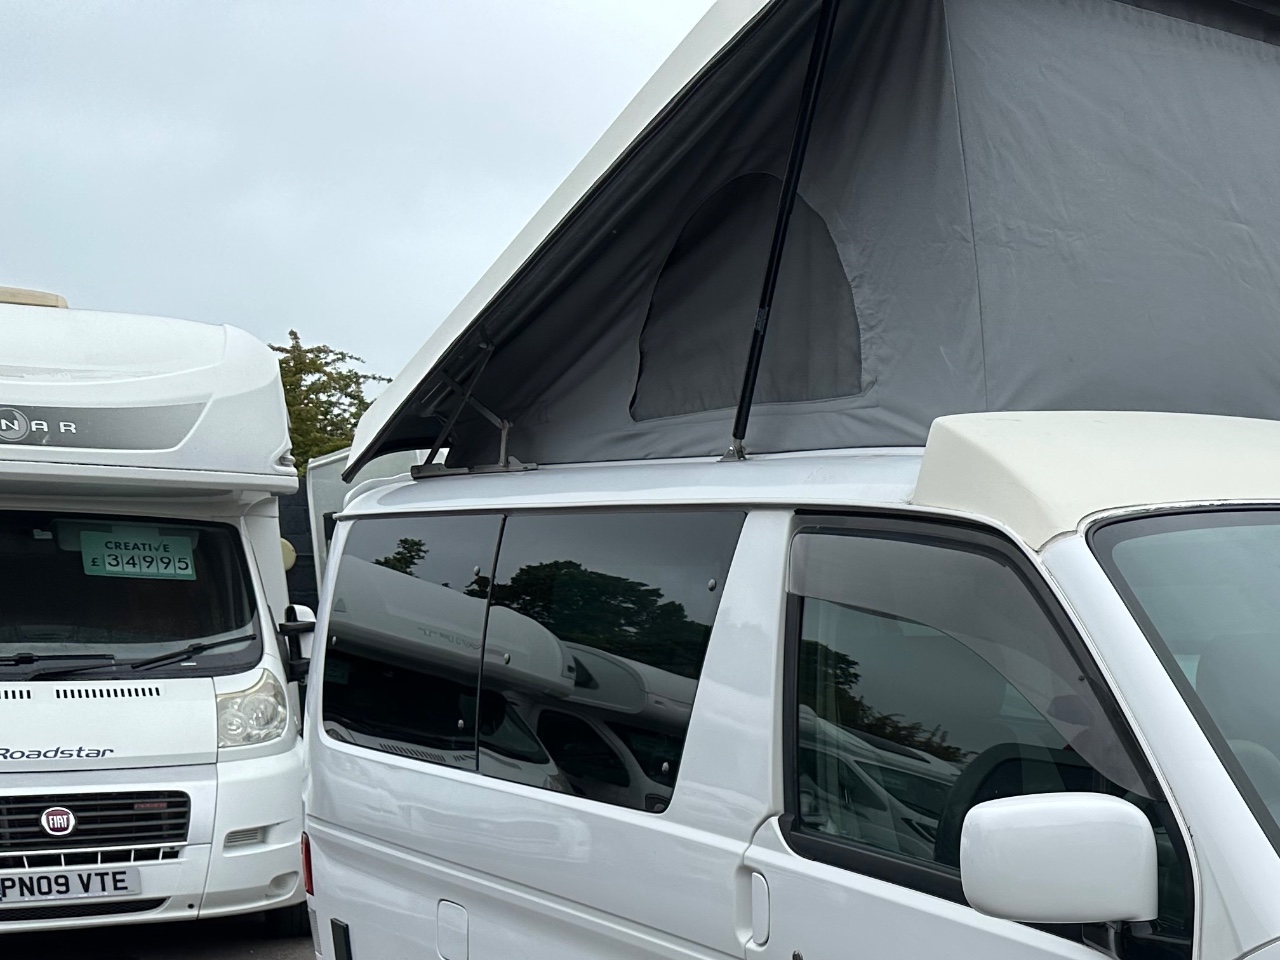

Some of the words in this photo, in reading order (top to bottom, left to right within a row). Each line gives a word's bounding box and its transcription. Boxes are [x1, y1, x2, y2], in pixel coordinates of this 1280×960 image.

[105, 540, 170, 553] CREATIVE
[48, 815, 69, 829] FIAT
[0, 874, 70, 898] PN09
[77, 870, 129, 893] VTE
